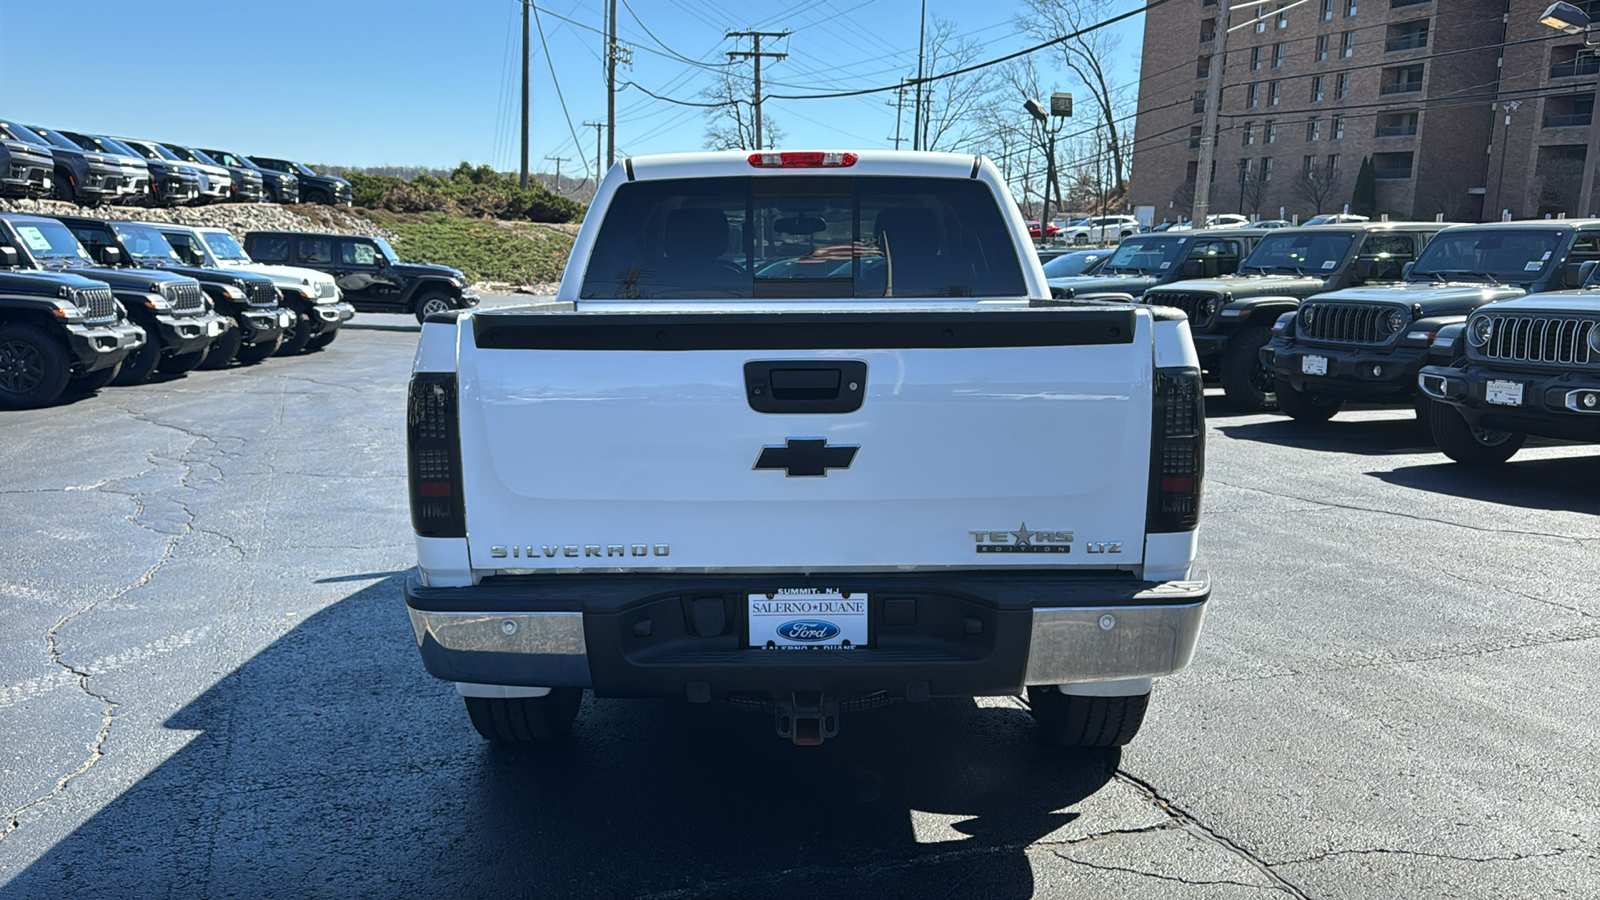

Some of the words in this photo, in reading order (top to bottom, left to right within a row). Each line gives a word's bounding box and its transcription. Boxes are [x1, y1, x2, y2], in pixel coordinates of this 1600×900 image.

[491, 543, 670, 558] SILVERADO
[1086, 541, 1123, 554] LTZ
[752, 602, 812, 613] SALERNO
[818, 602, 865, 613] DUANE
[788, 622, 828, 638] Ford
